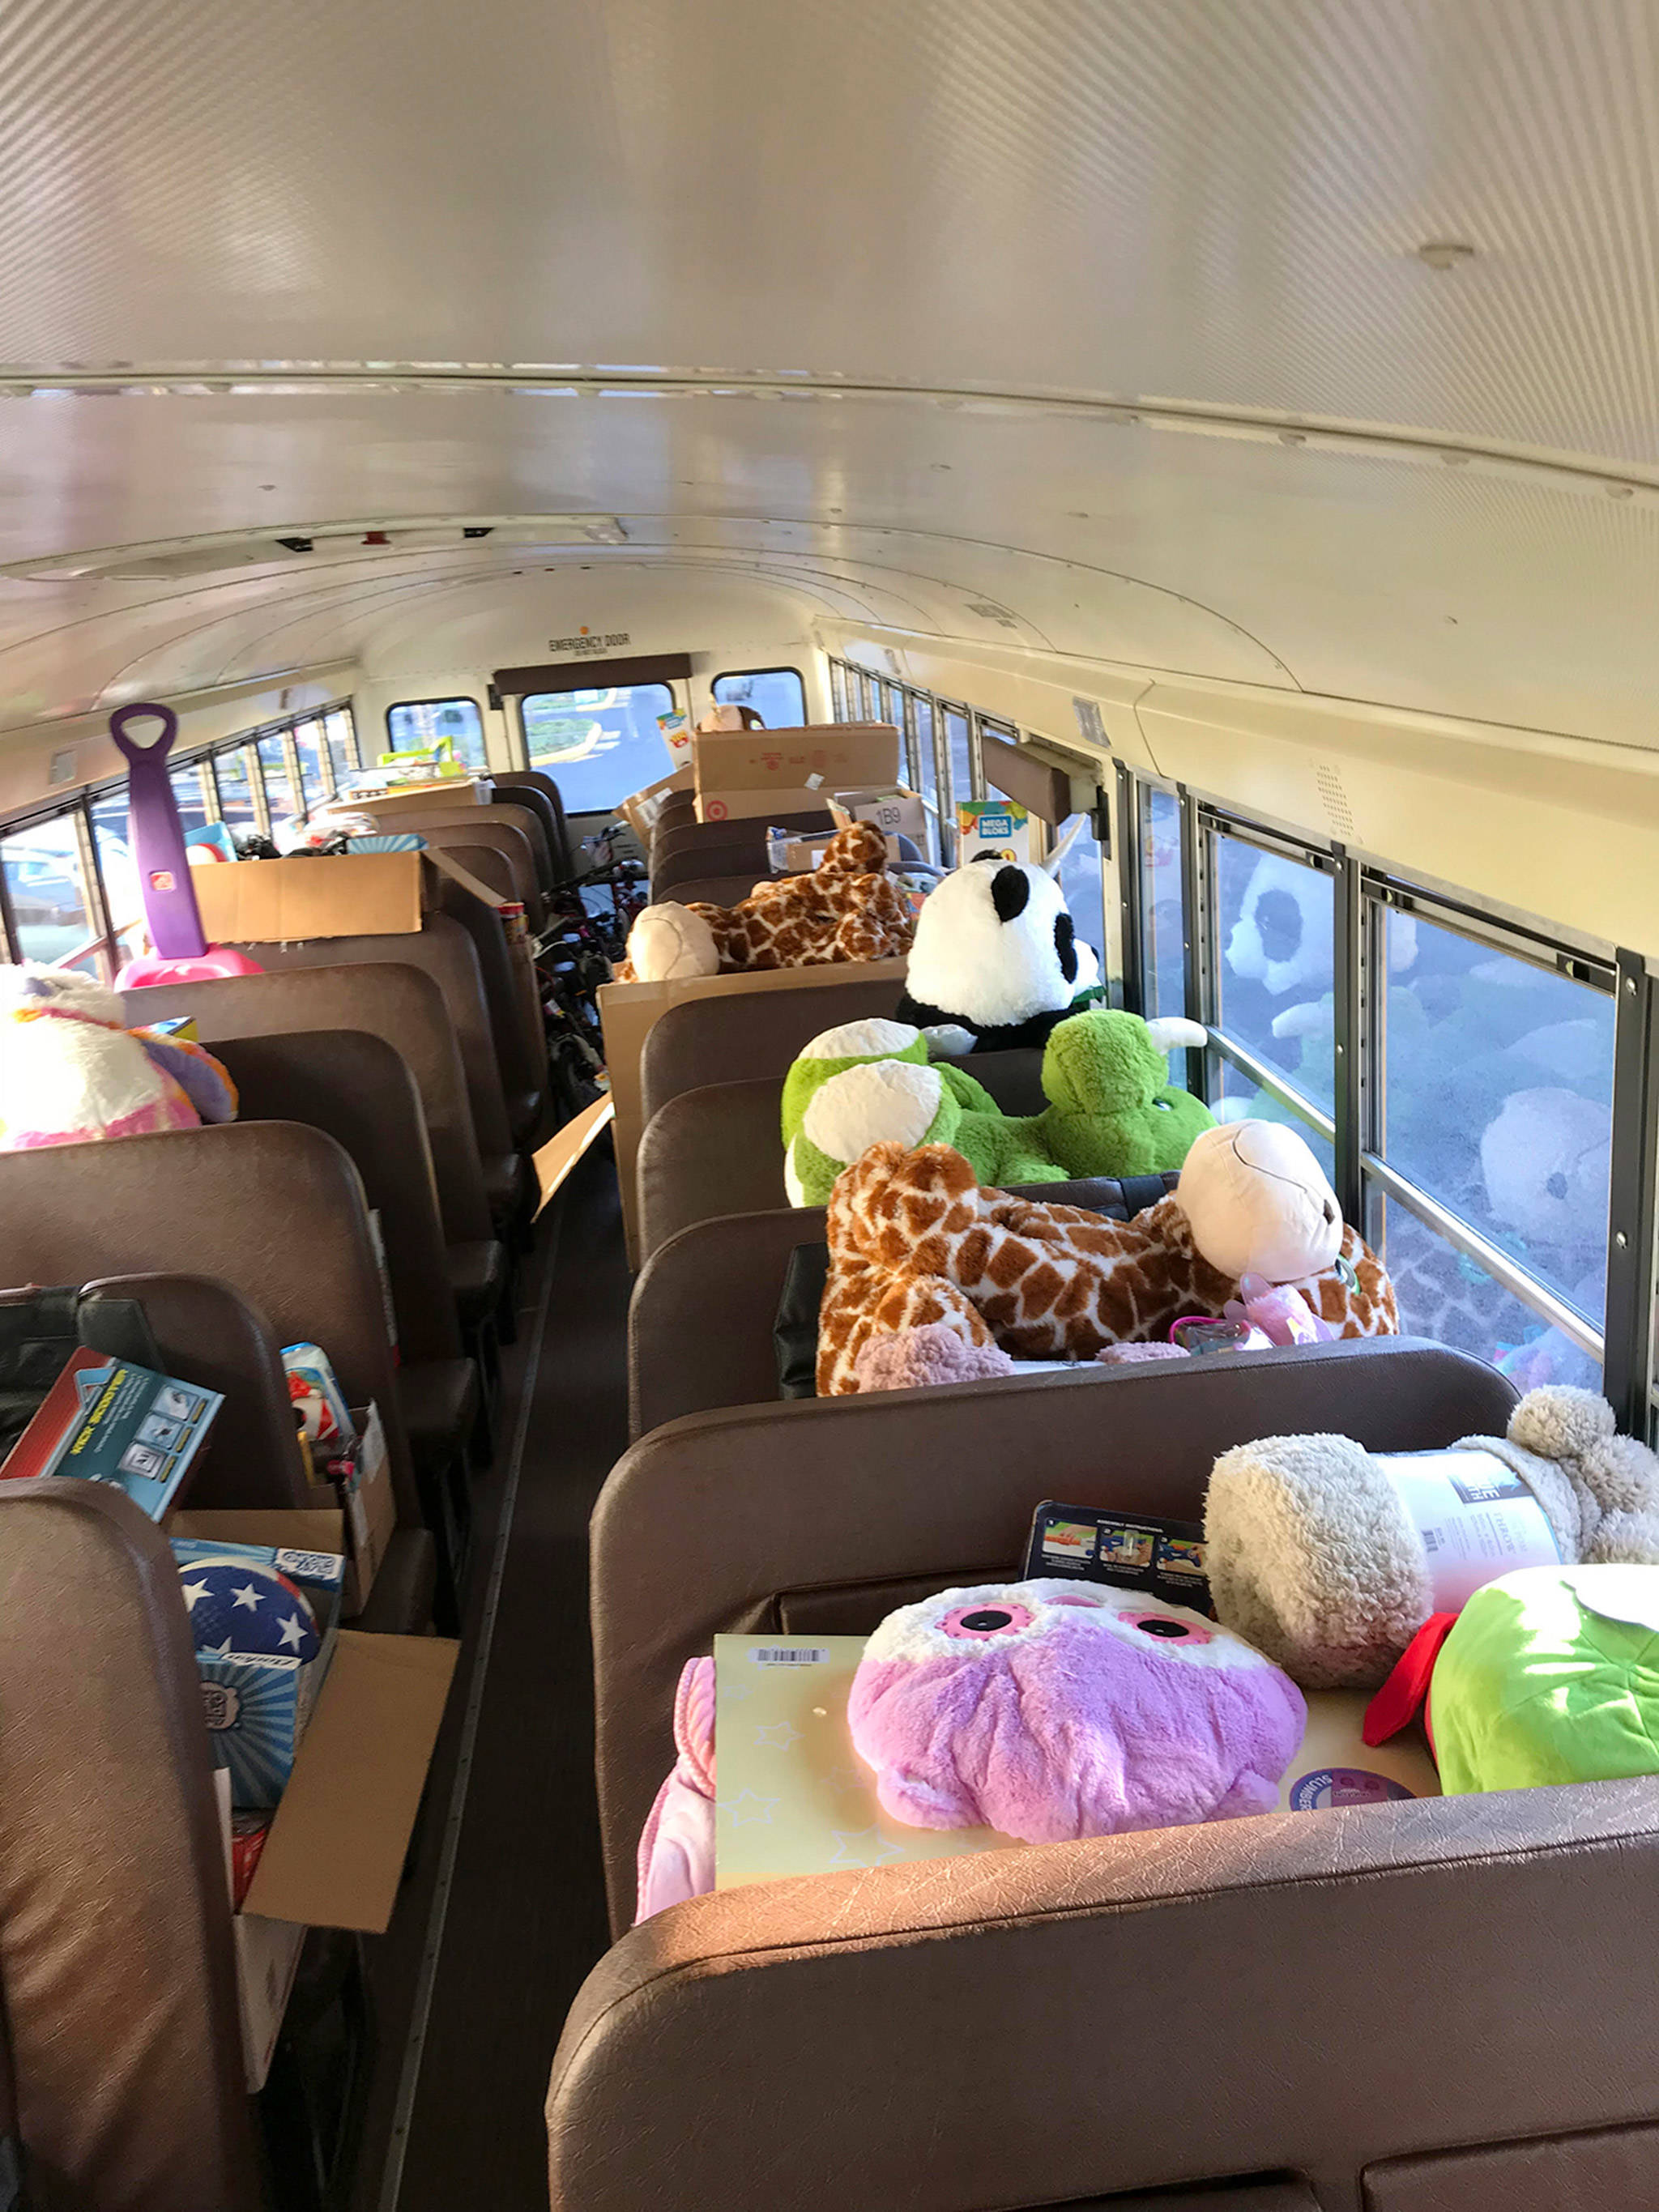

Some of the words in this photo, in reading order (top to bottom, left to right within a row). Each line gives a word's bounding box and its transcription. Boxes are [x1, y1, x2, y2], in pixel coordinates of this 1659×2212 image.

[548, 637, 602, 652] EMERGENCY
[604, 633, 630, 646] DOOR
[876, 808, 902, 825] 1B9
[982, 819, 1009, 827] MEGA
[982, 826, 1009, 835] BLOKS
[70, 1426, 95, 1455] KICK
[88, 1369, 128, 1424] SCOOTER
[1494, 1512, 1516, 1555] THROW
